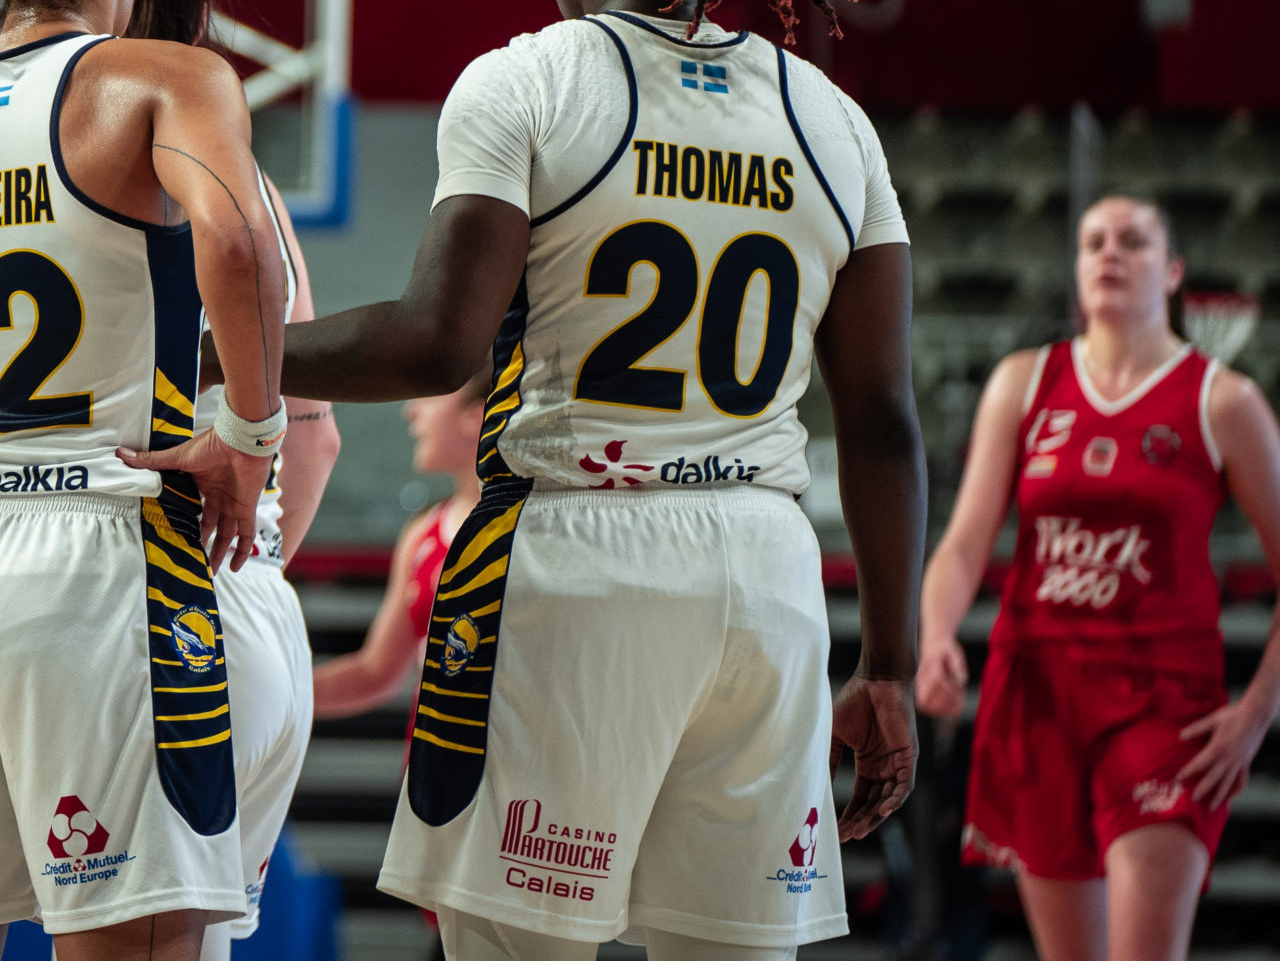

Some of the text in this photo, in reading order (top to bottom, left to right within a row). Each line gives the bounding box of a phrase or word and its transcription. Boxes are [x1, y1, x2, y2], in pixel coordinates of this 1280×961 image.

[633, 139, 796, 213] THOMAS
[573, 219, 801, 419] 20
[500, 799, 614, 871] PARTOUCHE
[547, 823, 617, 844] CASINO
[45, 850, 129, 875] Crédit Mutuel
[54, 868, 118, 886] Nord Europe
[506, 866, 595, 901] Calais
